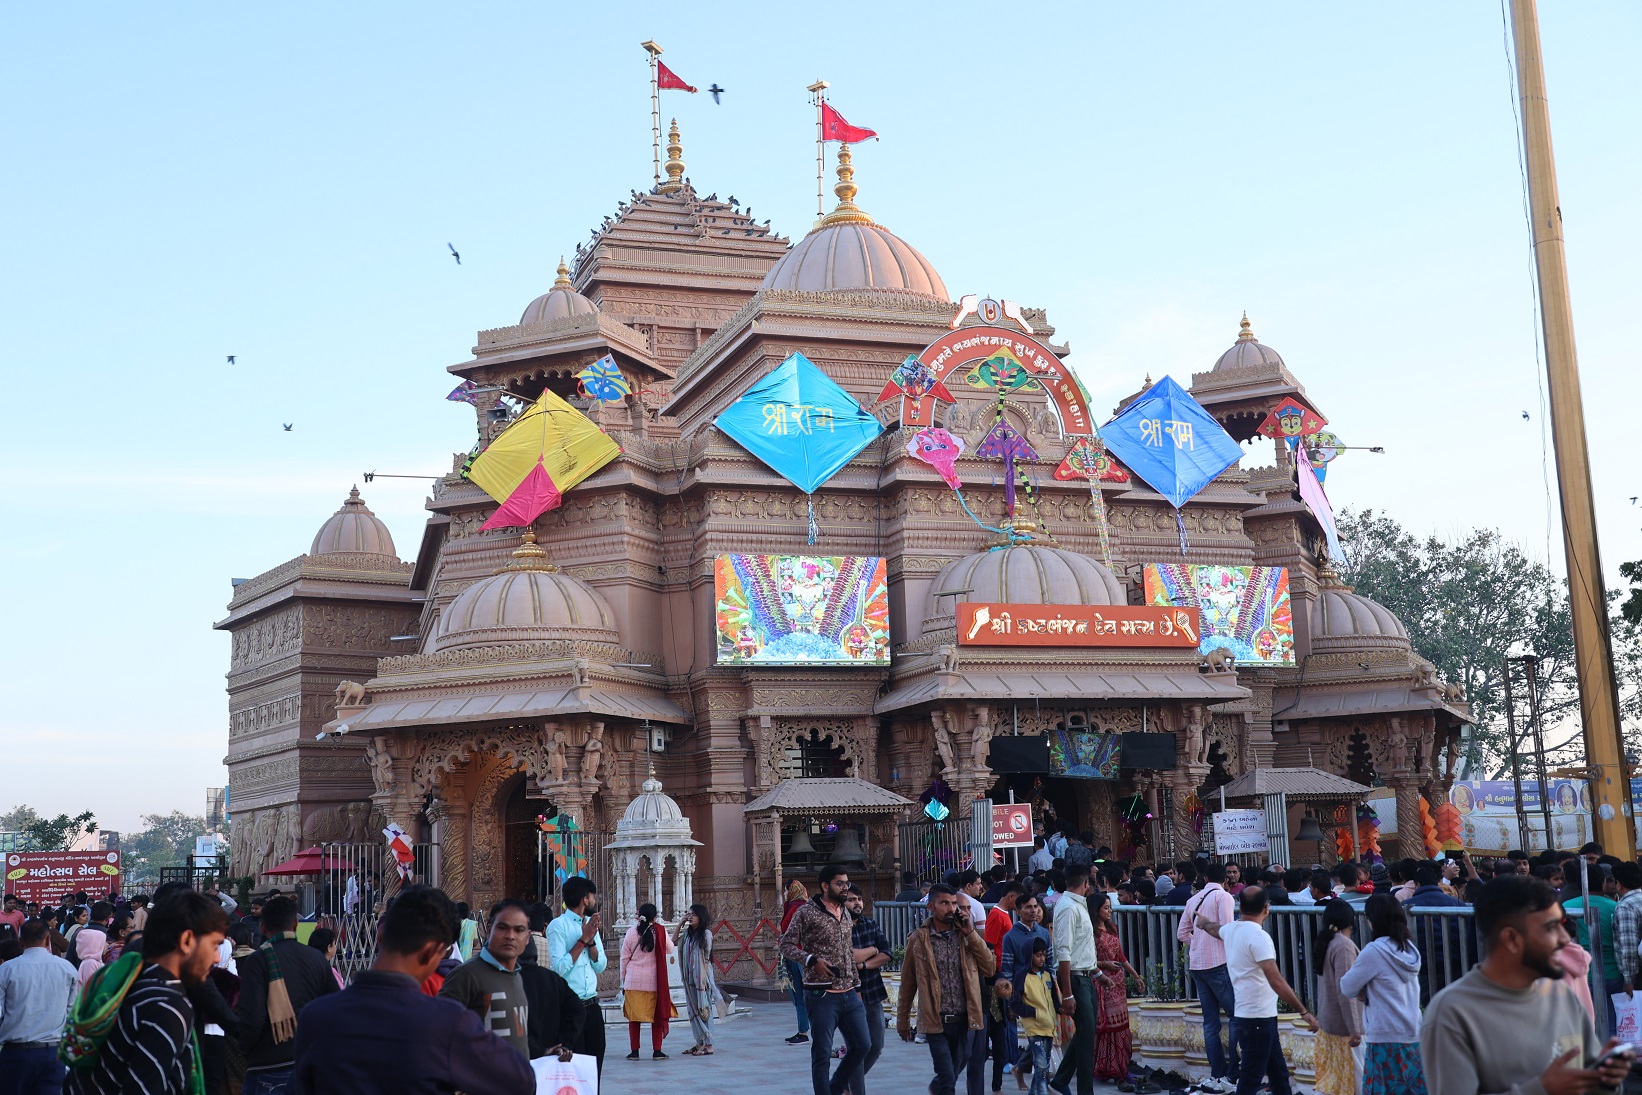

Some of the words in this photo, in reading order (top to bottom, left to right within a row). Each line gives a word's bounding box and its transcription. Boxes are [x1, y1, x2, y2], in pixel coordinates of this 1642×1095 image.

[929, 345, 953, 375] નુમતે
[762, 403, 788, 435] श्री
[1139, 418, 1163, 448] श्री
[1164, 419, 1194, 451] राम
[990, 611, 1012, 635] શ્રી
[1016, 613, 1089, 635] કષ્ટભંજન
[1093, 612, 1117, 636] દેવ
[1120, 619, 1155, 637] સત્ય
[992, 808, 1009, 816] BILE
[992, 820, 1004, 828] OT
[993, 832, 1015, 840] OWED
[29, 864, 73, 877] મહોત્સવ
[77, 863, 97, 876] સેલ
